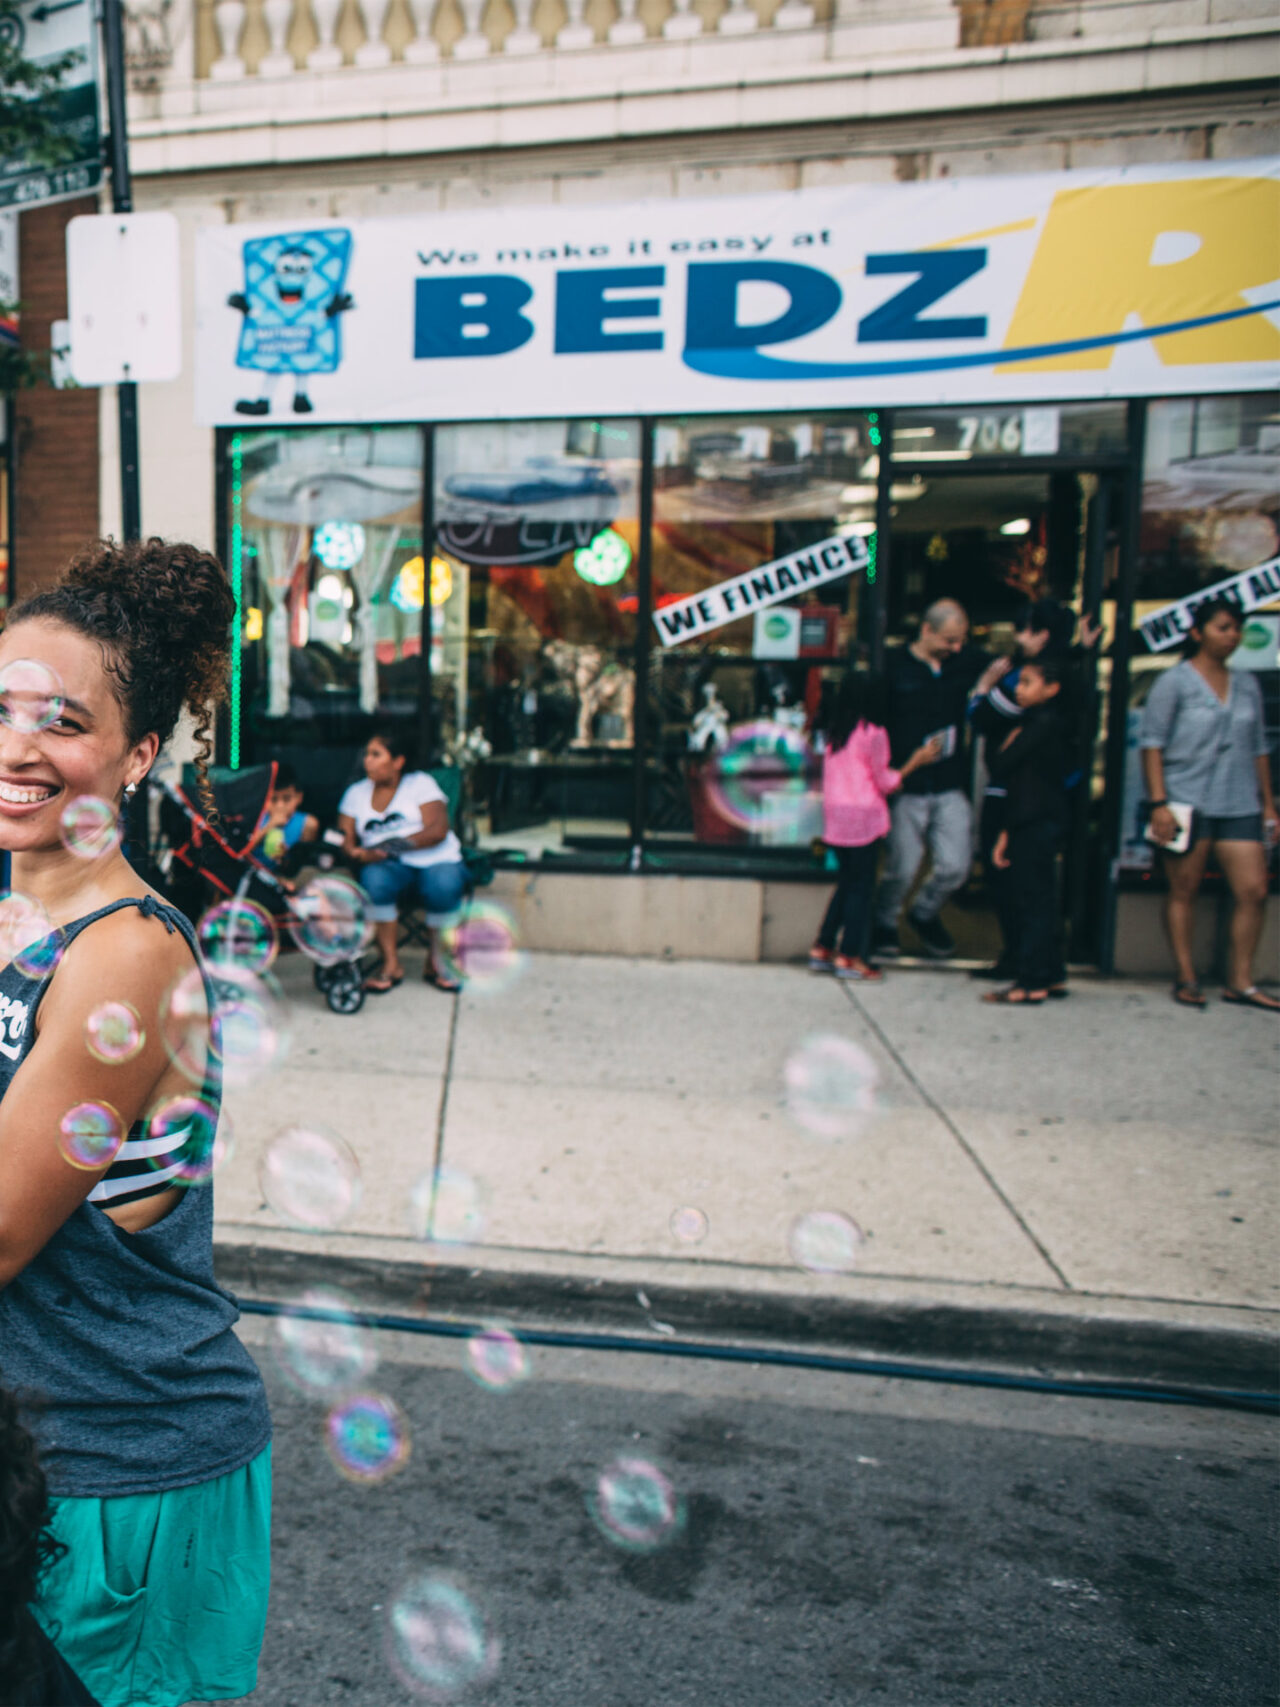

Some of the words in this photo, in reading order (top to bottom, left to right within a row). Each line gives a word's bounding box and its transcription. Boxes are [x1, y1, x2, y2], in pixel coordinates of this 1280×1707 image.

[417, 249, 480, 267] We
[497, 241, 610, 264] make
[629, 238, 653, 257] it
[670, 233, 774, 254] easy
[792, 228, 833, 247] at
[658, 602, 716, 642] WE
[722, 534, 871, 615] FINANCE
[1142, 608, 1183, 645] WE
